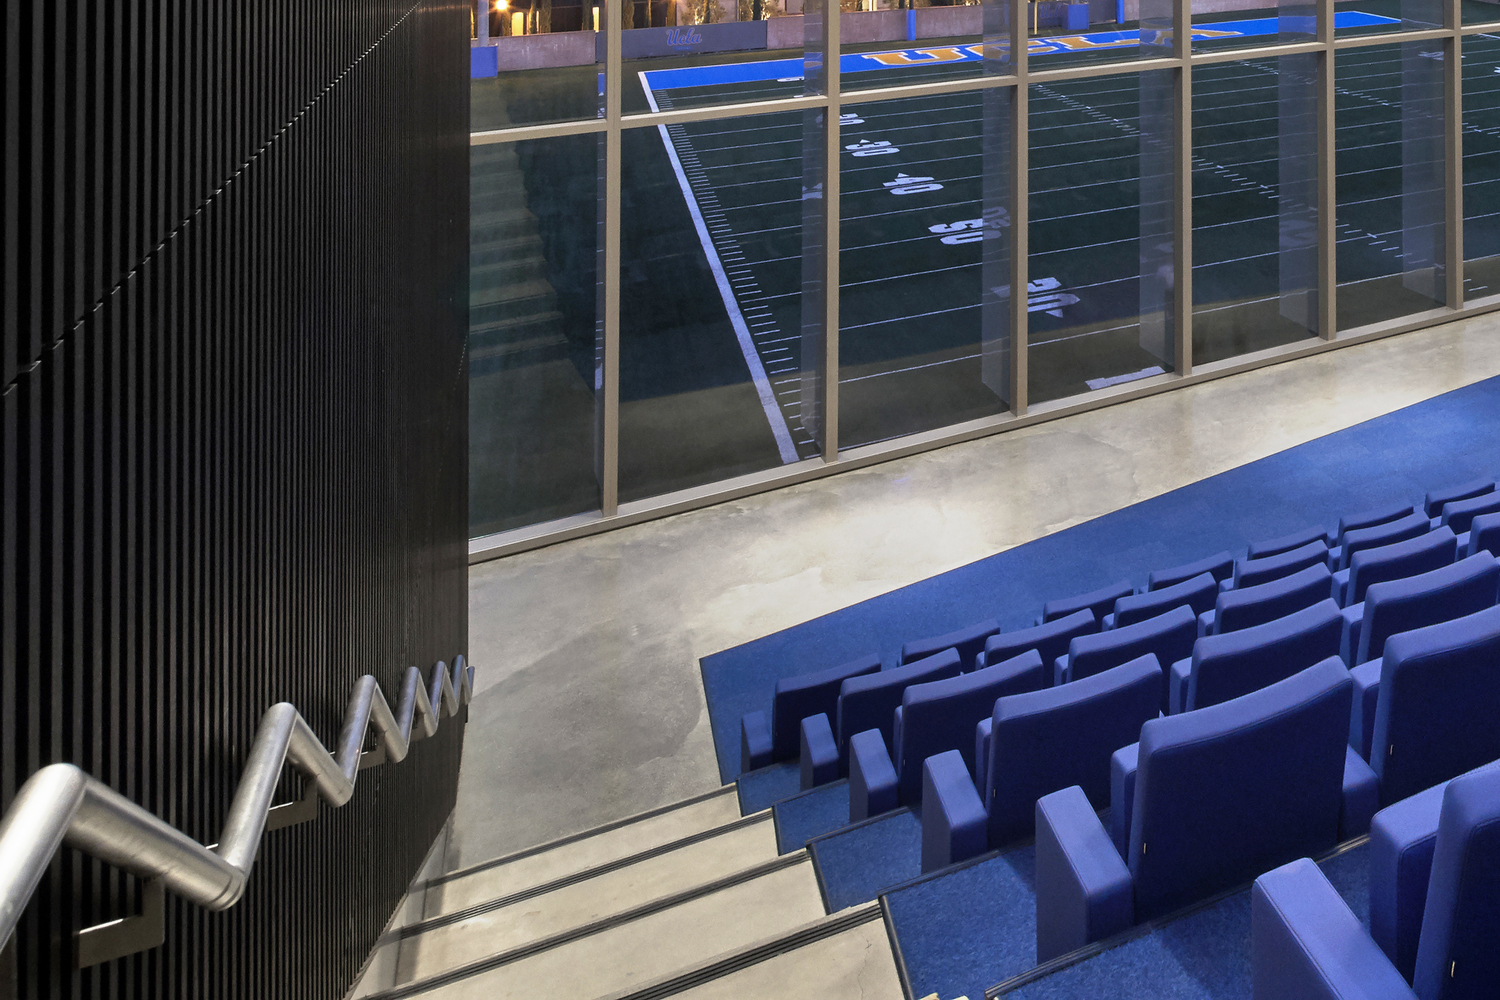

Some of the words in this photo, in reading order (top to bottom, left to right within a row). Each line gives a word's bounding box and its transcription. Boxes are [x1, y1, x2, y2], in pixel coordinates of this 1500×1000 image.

[665, 27, 703, 46] Ucla
[844, 140, 900, 157] 30
[882, 176, 944, 195] 40
[928, 217, 1002, 245] 50
